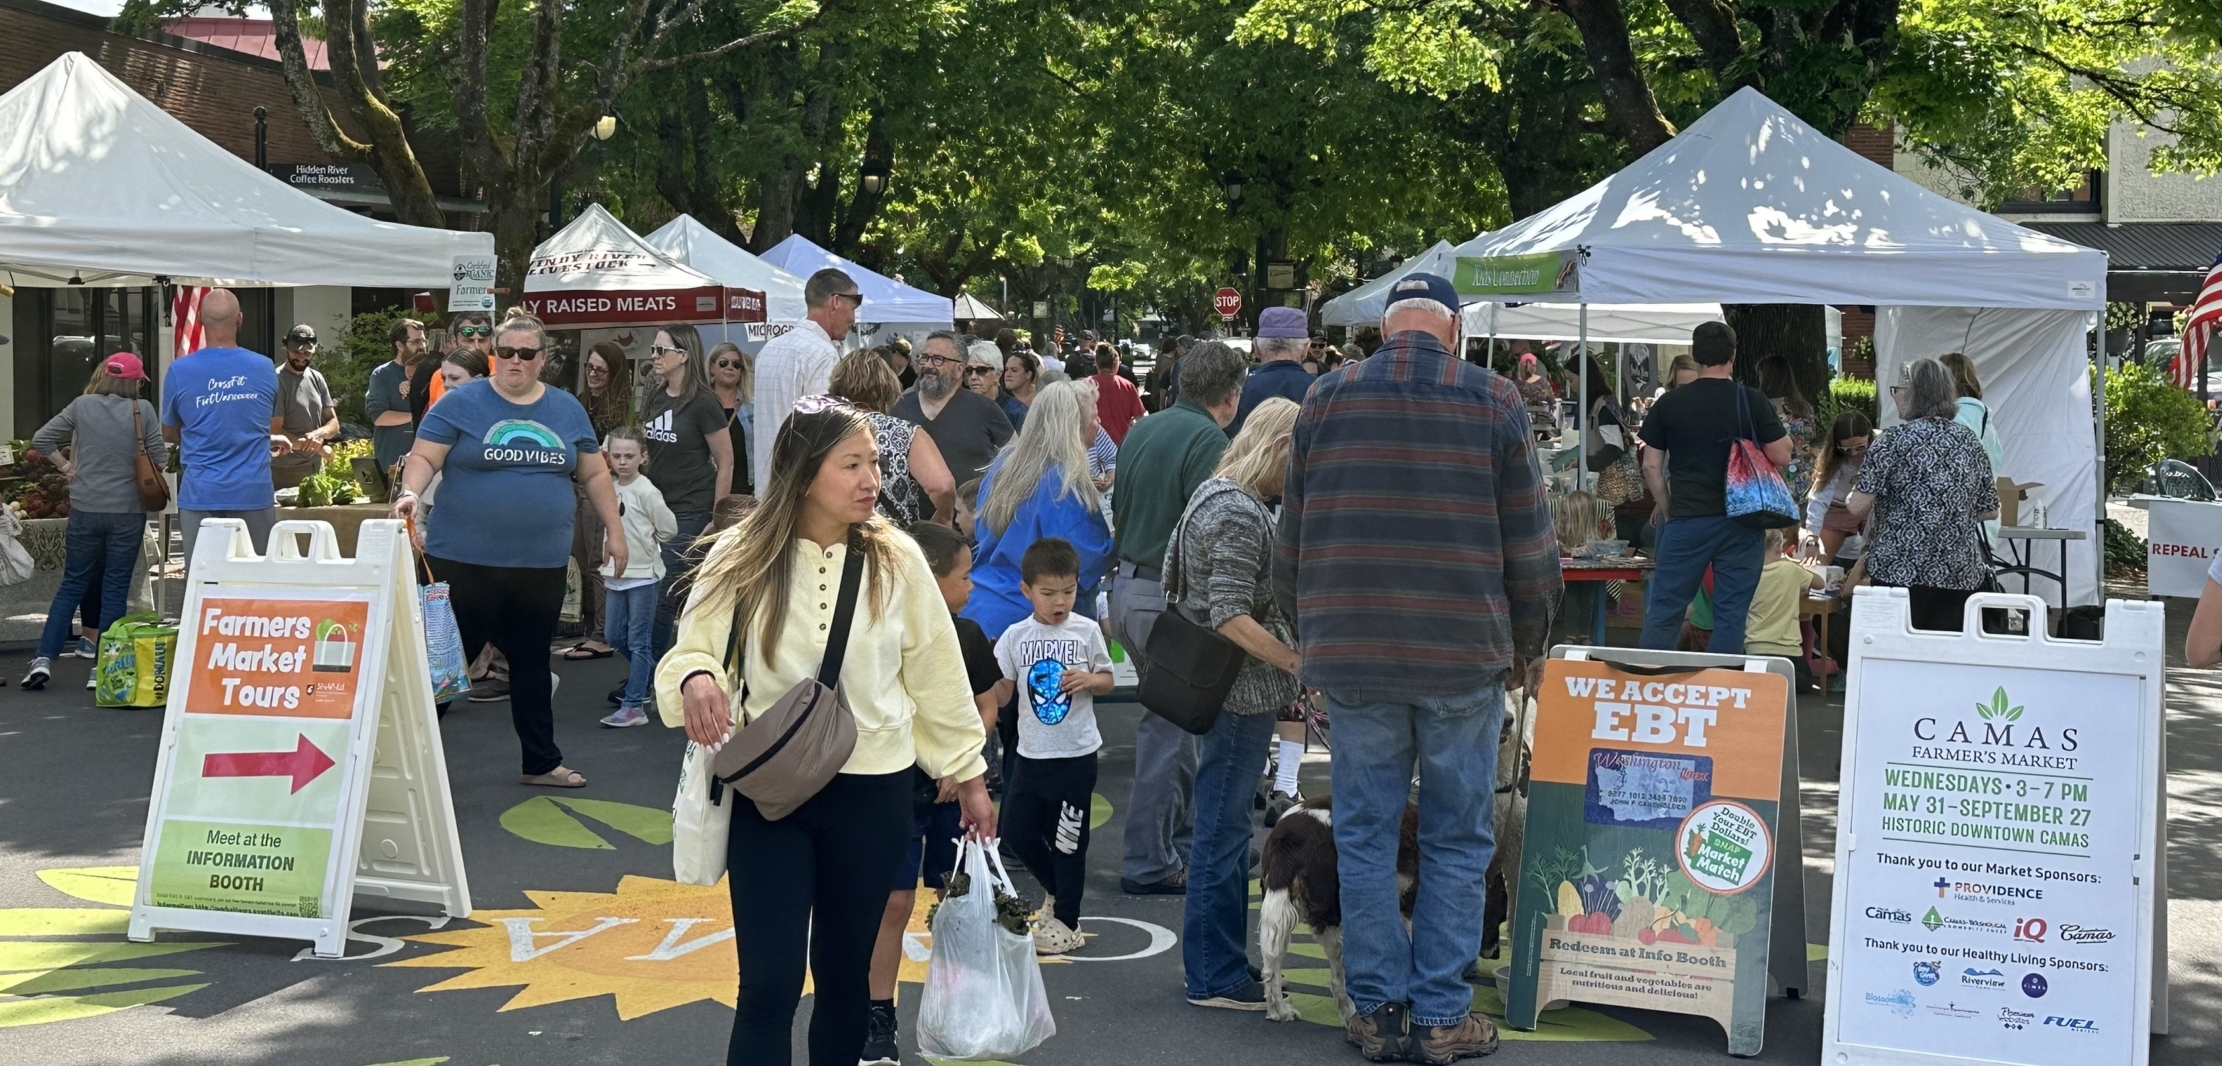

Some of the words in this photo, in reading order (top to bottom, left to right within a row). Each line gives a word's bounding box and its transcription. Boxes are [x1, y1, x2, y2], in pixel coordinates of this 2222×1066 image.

[290, 174, 317, 184] Coffee
[296, 165, 326, 174] Hidden
[327, 165, 349, 175] River
[547, 298, 611, 314] RAISED
[617, 296, 677, 312] MEATS
[1216, 296, 1240, 307] STOP
[208, 375, 248, 391] CrossFit
[484, 448, 523, 462] GOOD
[525, 450, 566, 465] VIBES
[2152, 543, 2208, 559] REPEAL
[203, 608, 311, 639] Farmers
[207, 642, 306, 673] Market
[1020, 639, 1089, 667] MARVEL
[221, 677, 300, 709] Tours
[1565, 676, 1616, 699] WE
[1620, 680, 1752, 709] ACCEPT
[1591, 701, 1717, 747] EBT
[1914, 717, 2078, 751] CAMAS
[1593, 752, 1681, 772] Washington
[1912, 746, 1996, 764] FARMER'S
[2001, 753, 2078, 770] MARKET
[1885, 768, 2003, 795] WEDNESDAYS
[2061, 783, 2088, 802] PM
[1720, 807, 1755, 829] Double
[1883, 792, 1920, 812] MAY
[2070, 808, 2092, 827] 27
[1055, 800, 1084, 854] NIKE
[1713, 812, 1735, 827] Your
[1735, 823, 1758, 839] EBT
[1882, 816, 1946, 835] HISTORIC
[1951, 822, 2034, 843] DOWNTOWN
[2040, 830, 2089, 848] CAMAS
[206, 829, 240, 846] Meet
[243, 834, 257, 847] at
[260, 833, 282, 848] the
[1714, 838, 1741, 853] SNAP
[186, 850, 295, 871] INFORMATION
[1697, 843, 1746, 869] Market
[1877, 852, 1915, 867] Thank
[1917, 858, 1942, 870] you
[1945, 859, 1958, 870] to
[1961, 862, 1982, 873] our
[1986, 863, 2032, 878] Market
[2036, 867, 2102, 884] Sponsors:
[1696, 856, 1740, 882] Match
[209, 874, 264, 892] BOOTH
[1955, 882, 2043, 900] PROVIDENCE
[1865, 906, 1912, 922] Camas
[2013, 917, 2047, 943] iQ
[2059, 924, 2116, 941] Camas
[1549, 938, 1616, 956] Redeem
[1619, 946, 1636, 957] at
[1638, 947, 1673, 962] Info
[1676, 951, 1727, 968] Booth
[1865, 937, 1899, 951] Thank
[1901, 943, 1923, 954] you
[1926, 944, 1938, 954] to
[1940, 947, 1960, 957] our
[1962, 947, 2008, 964] Healthy
[2010, 952, 2046, 968] Living
[2049, 957, 2109, 973] Sponsors:
[1560, 967, 1588, 978] Local
[1589, 970, 1613, 980] fruit
[1614, 973, 1635, 983] and
[1636, 976, 1692, 989] vegetables
[1694, 984, 1712, 992] are
[1572, 979, 1623, 991] nutritious
[1625, 983, 1645, 994] and
[1647, 986, 1698, 1000] delicious!
[1961, 976, 2005, 987] Riverview
[2043, 1016, 2099, 1031] FUEL
